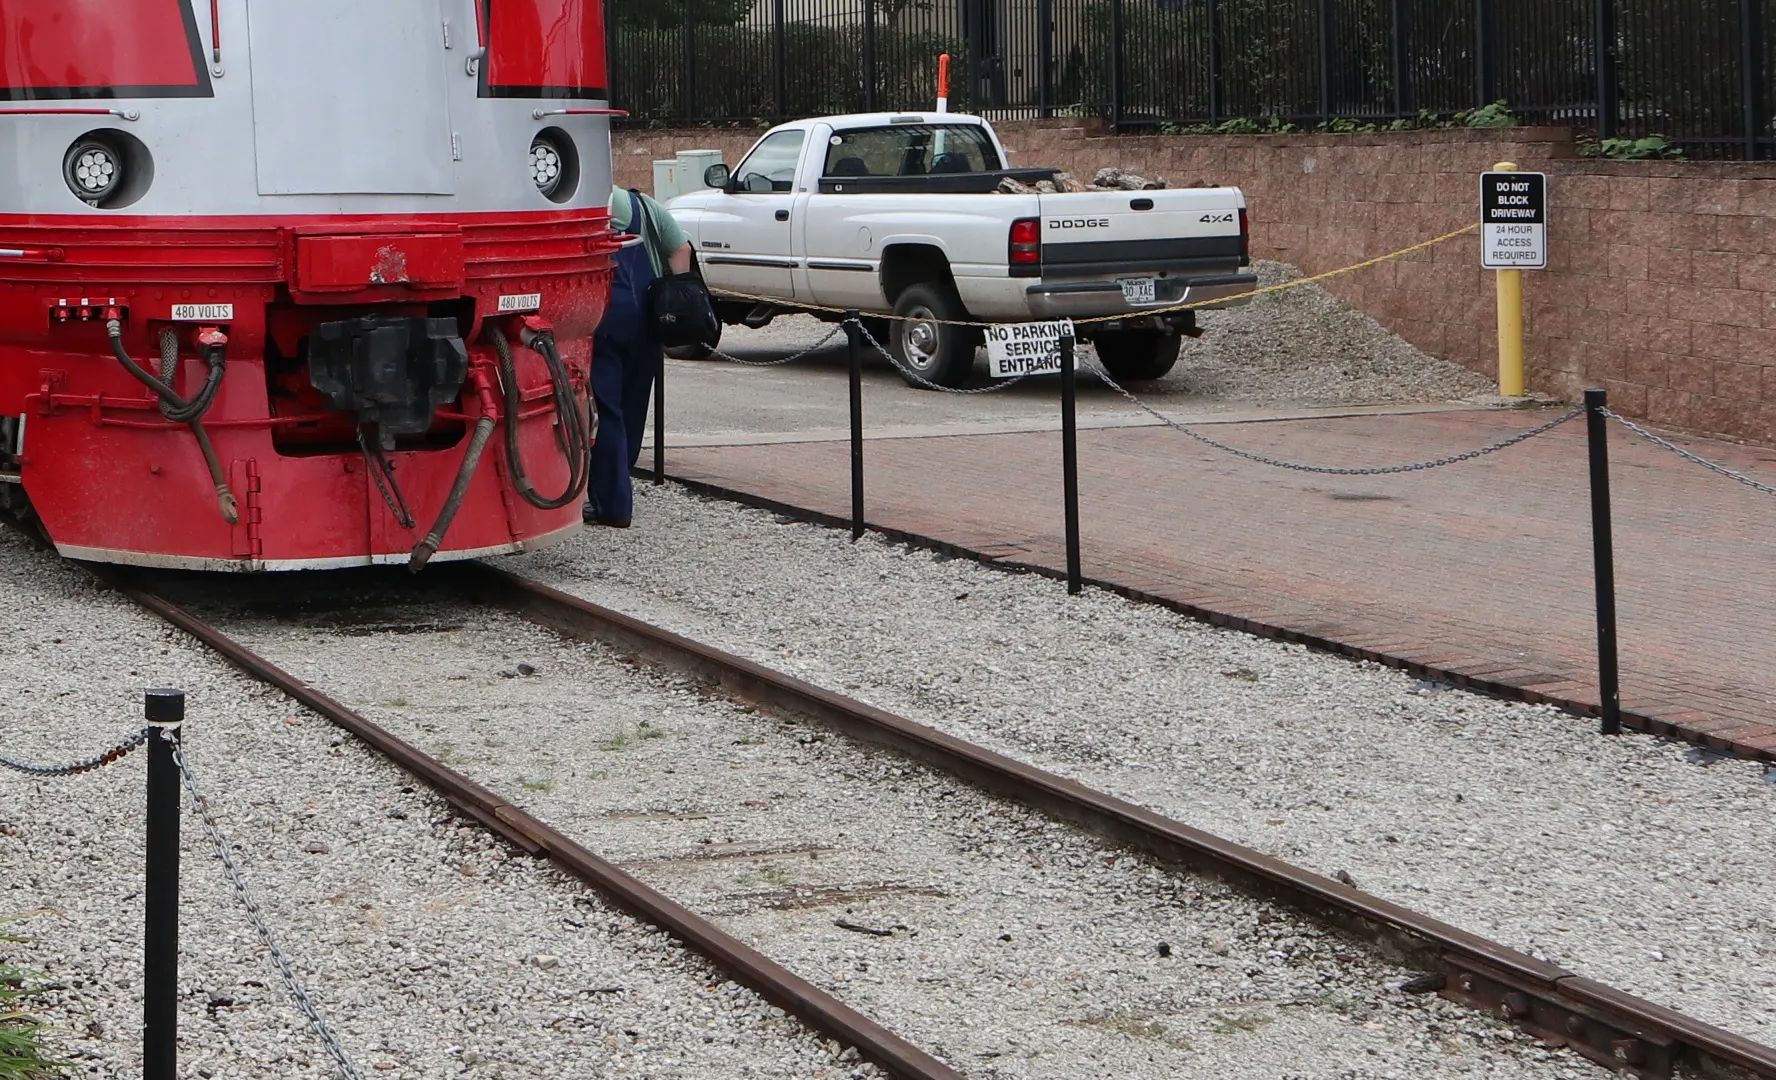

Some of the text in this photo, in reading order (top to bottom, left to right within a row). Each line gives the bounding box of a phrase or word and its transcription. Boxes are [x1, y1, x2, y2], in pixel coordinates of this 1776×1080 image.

[1496, 182, 1530, 192] DO NOT
[1498, 195, 1529, 205] BLOCK
[1491, 208, 1536, 218] DRIVEWAY
[1049, 218, 1109, 229] DODGE
[1496, 225, 1532, 234] 24 HOUR
[1497, 238, 1532, 247] ACCESS
[1492, 251, 1536, 260] REQUIRED
[501, 295, 538, 309] 480 VOLTS
[175, 305, 229, 318] 480 VOLTS
[989, 323, 1071, 341] NO PARKING
[999, 356, 1062, 373] ENTRANC
